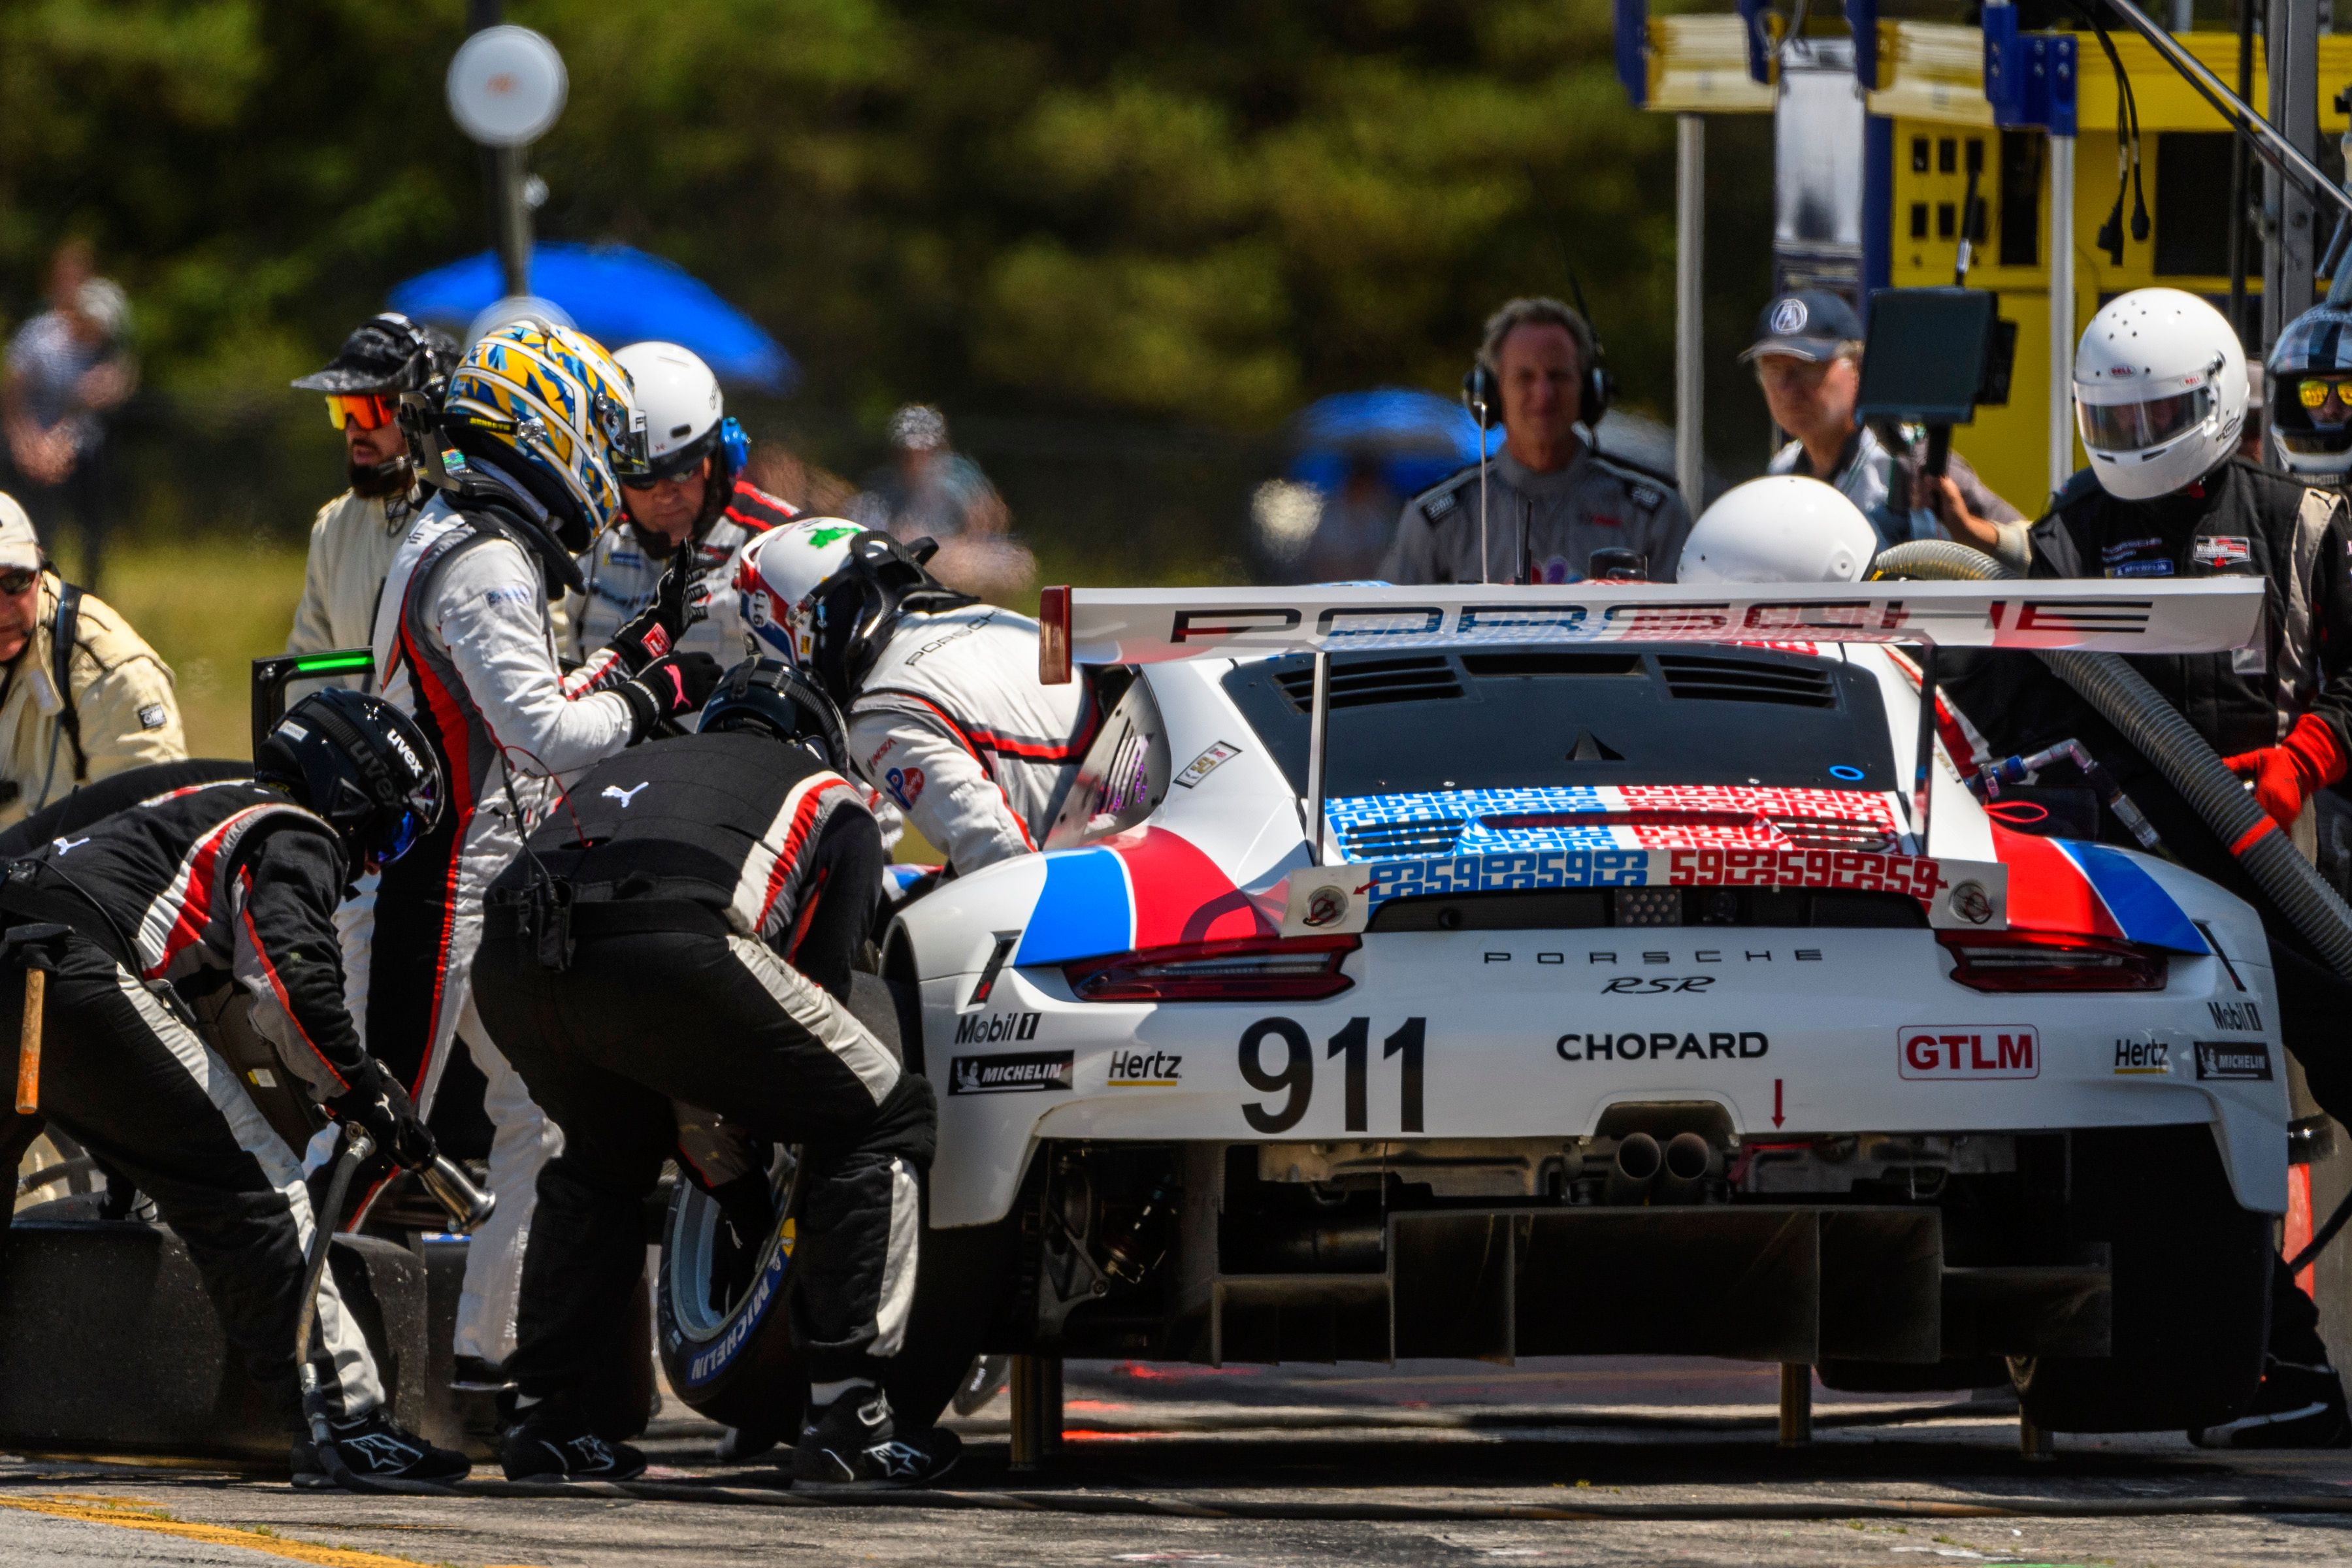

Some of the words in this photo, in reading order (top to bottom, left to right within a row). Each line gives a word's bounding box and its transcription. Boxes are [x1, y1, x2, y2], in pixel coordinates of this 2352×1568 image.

[1170, 600, 2153, 644] PORSCHE
[386, 728, 424, 779] uvex
[1484, 949, 1823, 965] PORSCHE
[1601, 975, 1716, 994] RSR
[955, 1013, 1019, 1044] Mobil
[2207, 1001, 2250, 1031] Mobil
[1556, 1032, 1769, 1061] CHOPARD
[1906, 1034, 2033, 1070] GTLM
[2114, 1039, 2168, 1067] Hertz
[982, 1063, 1062, 1083] MICHELIN
[1108, 1051, 1181, 1079] Hertz
[1238, 1016, 1427, 1134] 911
[2219, 1054, 2266, 1070] MICHELIN
[691, 1275, 771, 1380] MICHELIN
